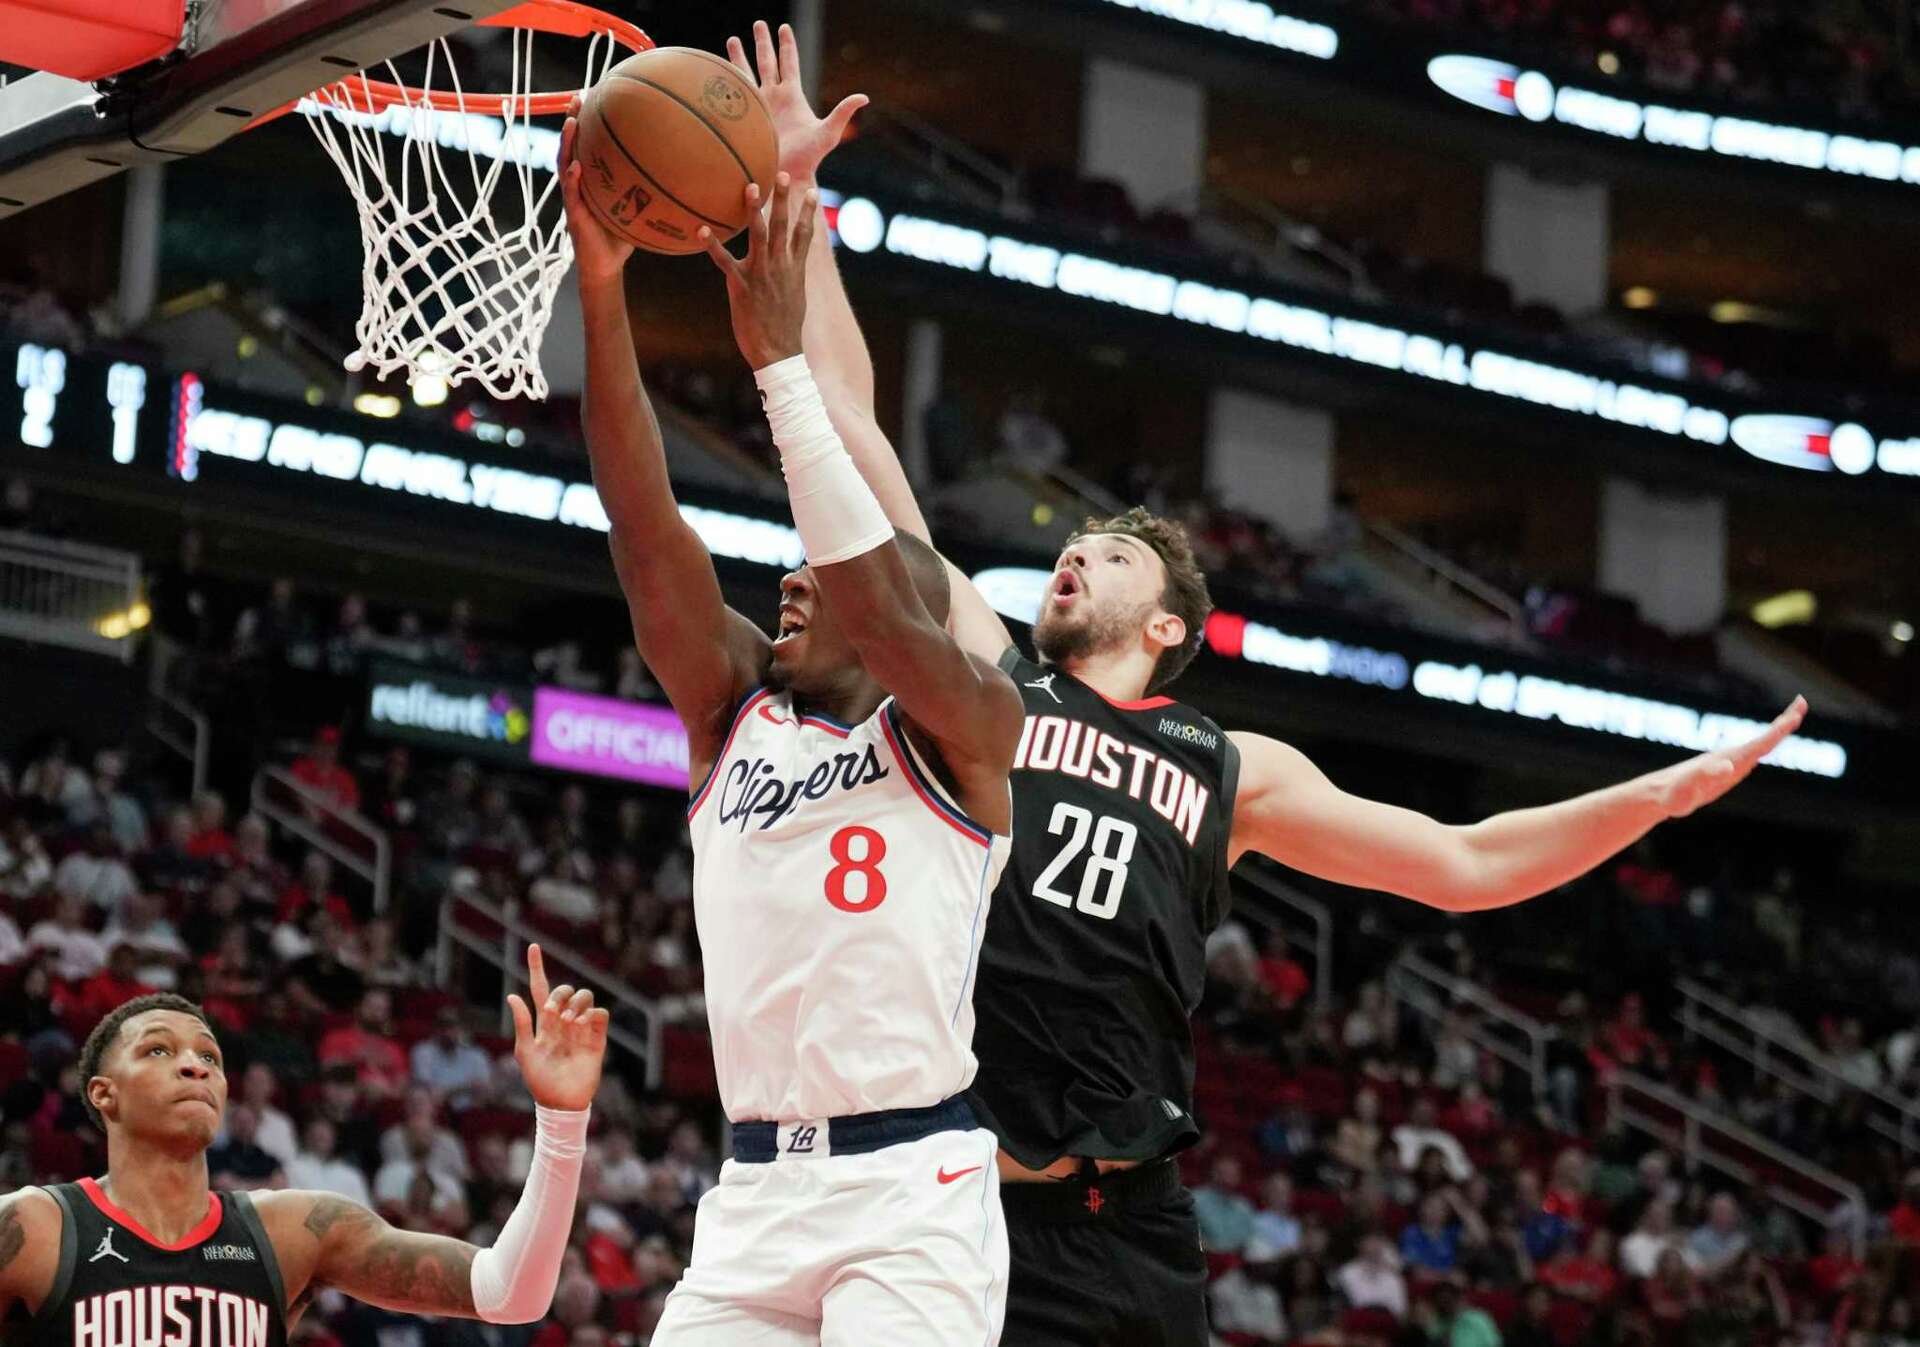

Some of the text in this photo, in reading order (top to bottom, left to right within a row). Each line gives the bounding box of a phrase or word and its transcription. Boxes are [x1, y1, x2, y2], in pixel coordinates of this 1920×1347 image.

[824, 826, 887, 913] 8
[1032, 802, 1138, 920] 28
[73, 1285, 269, 1346] HOUSTON
